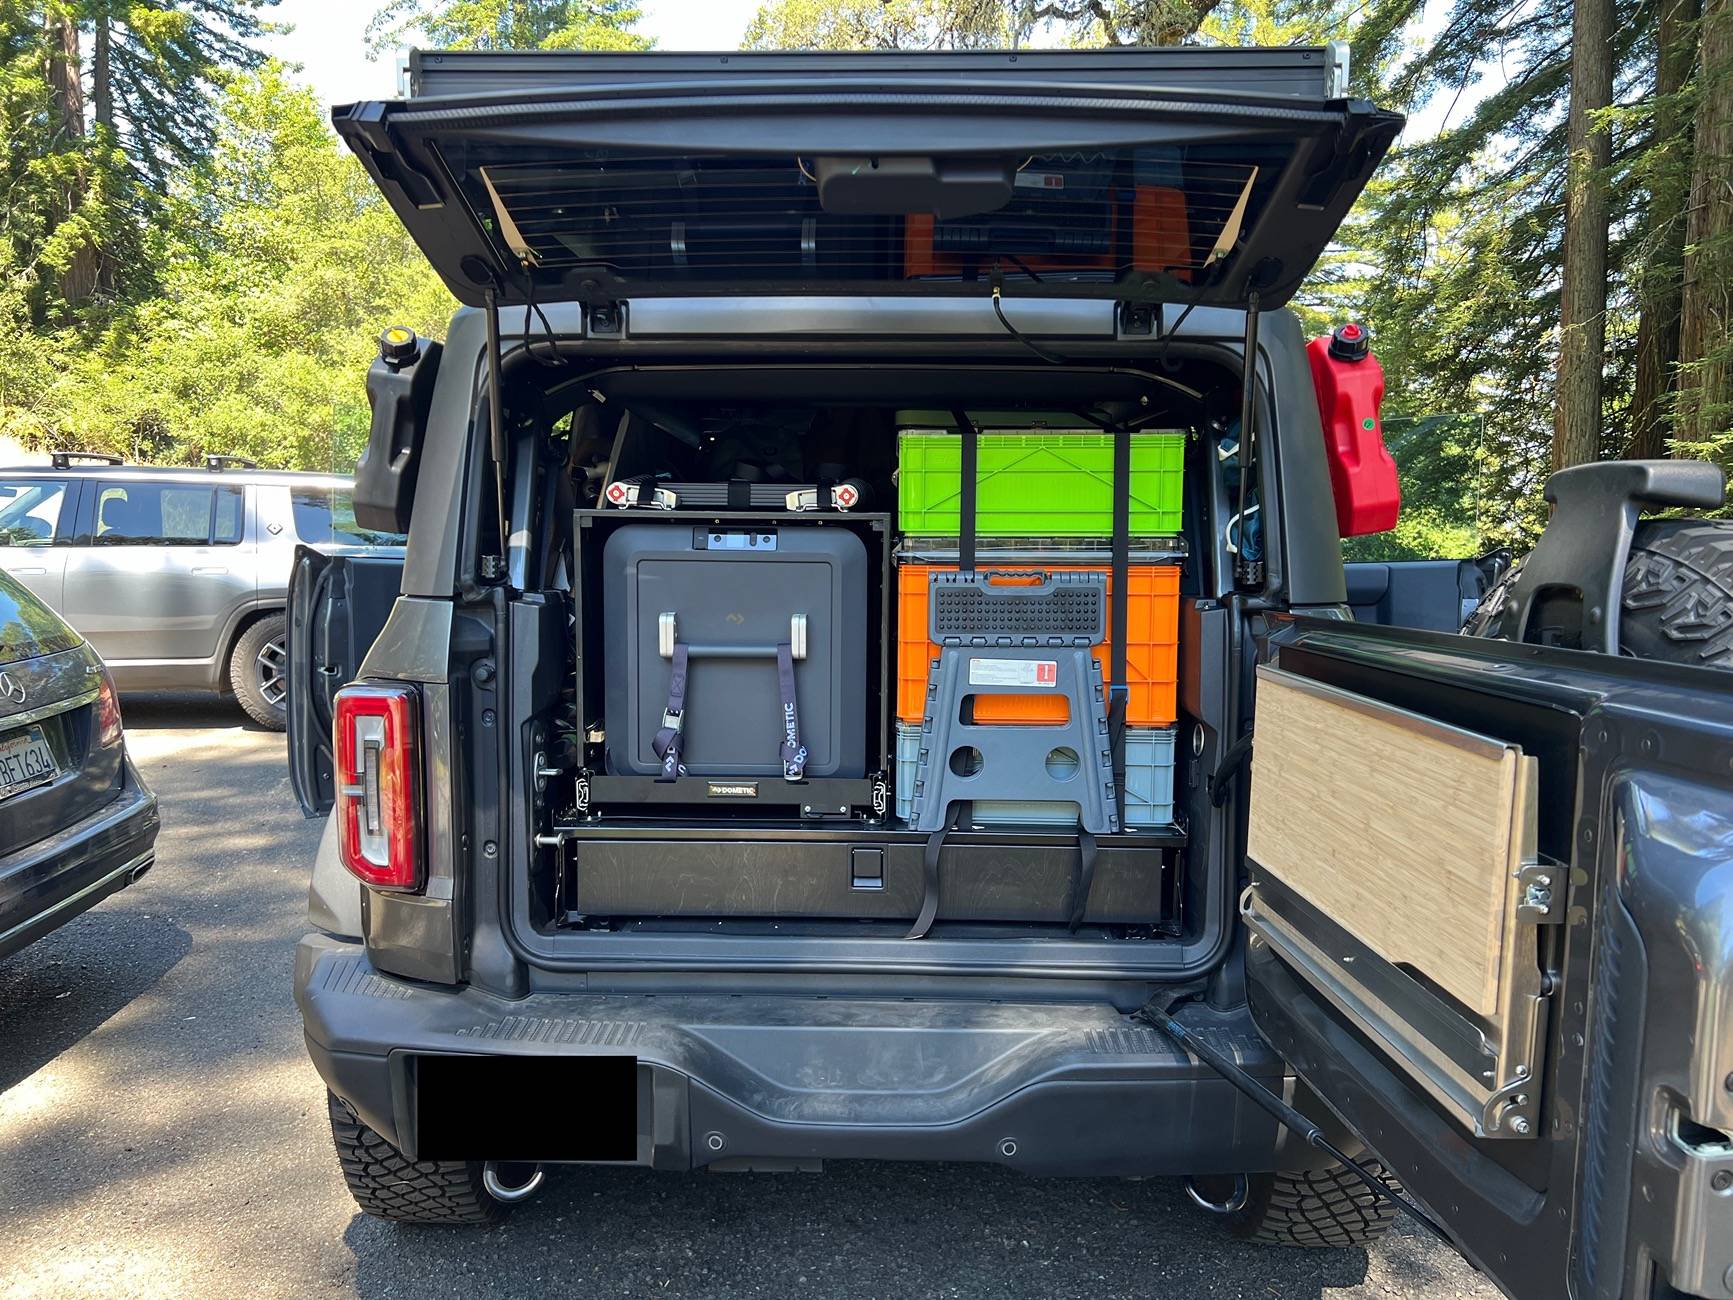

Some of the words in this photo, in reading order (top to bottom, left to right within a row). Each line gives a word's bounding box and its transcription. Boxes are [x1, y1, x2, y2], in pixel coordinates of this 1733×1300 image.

[784, 702, 797, 749] OMETIC
[0, 746, 52, 786] BFT634
[722, 786, 756, 794] DOMETIC
